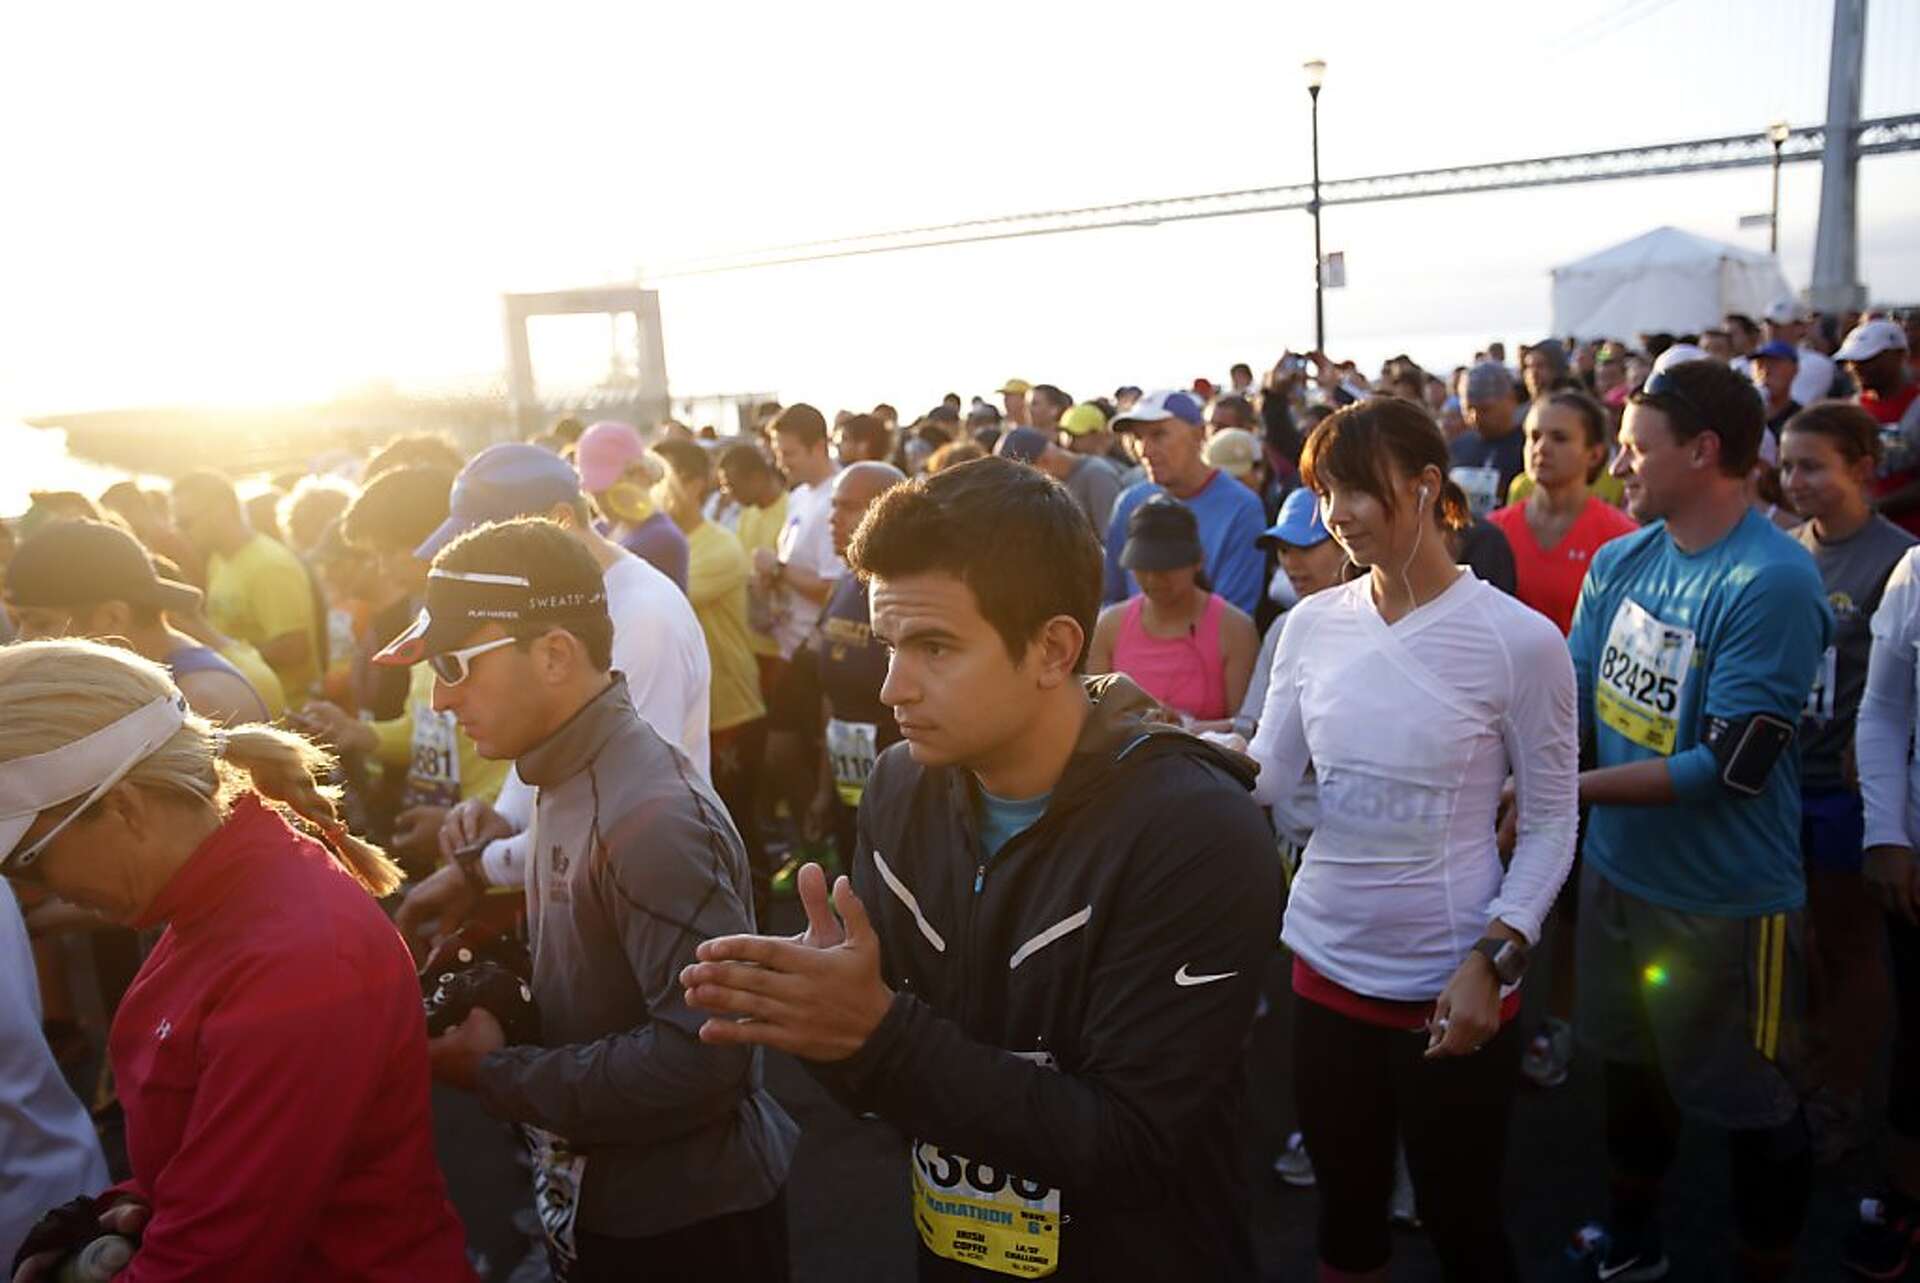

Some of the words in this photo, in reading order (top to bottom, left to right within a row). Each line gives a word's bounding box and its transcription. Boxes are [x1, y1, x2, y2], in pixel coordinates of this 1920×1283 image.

[1602, 646, 1679, 713] 82425
[926, 1198, 1014, 1225] MARATHON
[956, 1230, 985, 1242] IRISH
[953, 1241, 988, 1254] COFFEE
[1005, 1251, 1049, 1265] CHALLENGE
